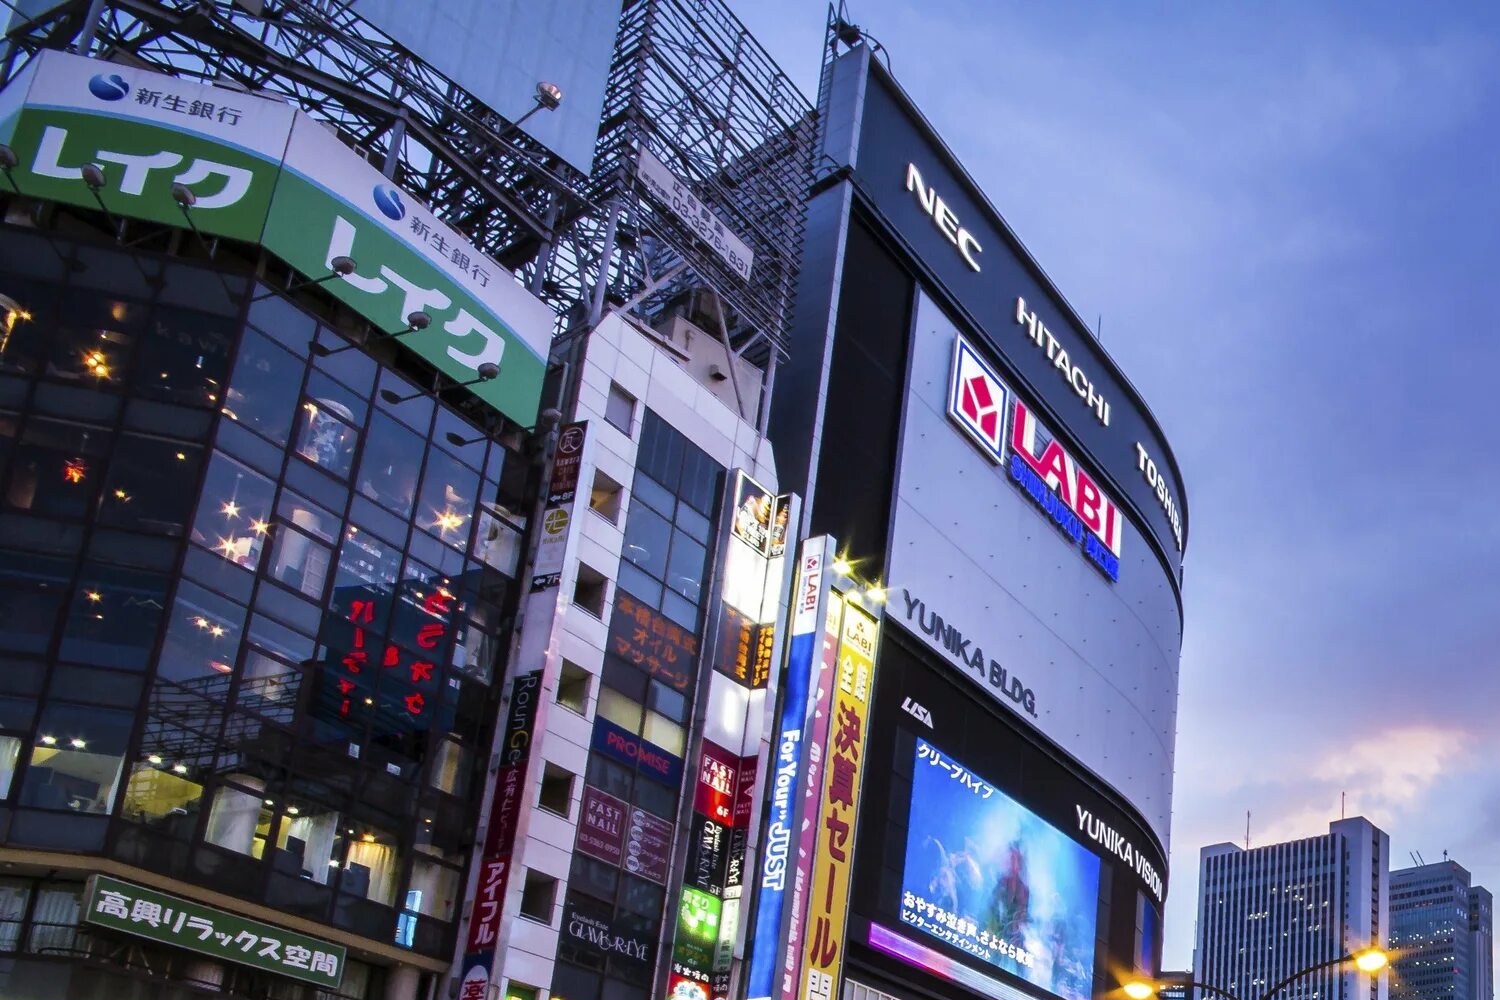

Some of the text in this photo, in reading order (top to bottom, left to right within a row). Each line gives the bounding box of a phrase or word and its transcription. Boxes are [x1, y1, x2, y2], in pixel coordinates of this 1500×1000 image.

[135, 88, 242, 127] 新生銀行
[32, 125, 254, 209] レイク
[410, 215, 491, 289] 新生銀行
[905, 161, 982, 273] NEC
[325, 215, 506, 375] レイク
[1016, 296, 1111, 427] HITACHI
[1009, 453, 1083, 543] SHINJUKU
[1012, 399, 1123, 559] LABI
[1135, 440, 1183, 551] TOSHIBA
[804, 573, 819, 612] LABI
[846, 626, 872, 652] LABI
[903, 588, 1039, 720] YUNIKA BLDG.
[606, 730, 672, 775] PROMISE
[901, 696, 934, 729] LISA
[702, 772, 732, 796] NAIL
[703, 755, 734, 781] FAST
[587, 813, 618, 835] NAIL
[588, 800, 622, 822] FAST
[716, 805, 730, 819] 6F
[763, 729, 800, 892] For Your JUST
[1076, 803, 1164, 904] YUNIKA VISION
[96, 888, 340, 977] 高興リラックス空間
[473, 861, 505, 946] アイフル
